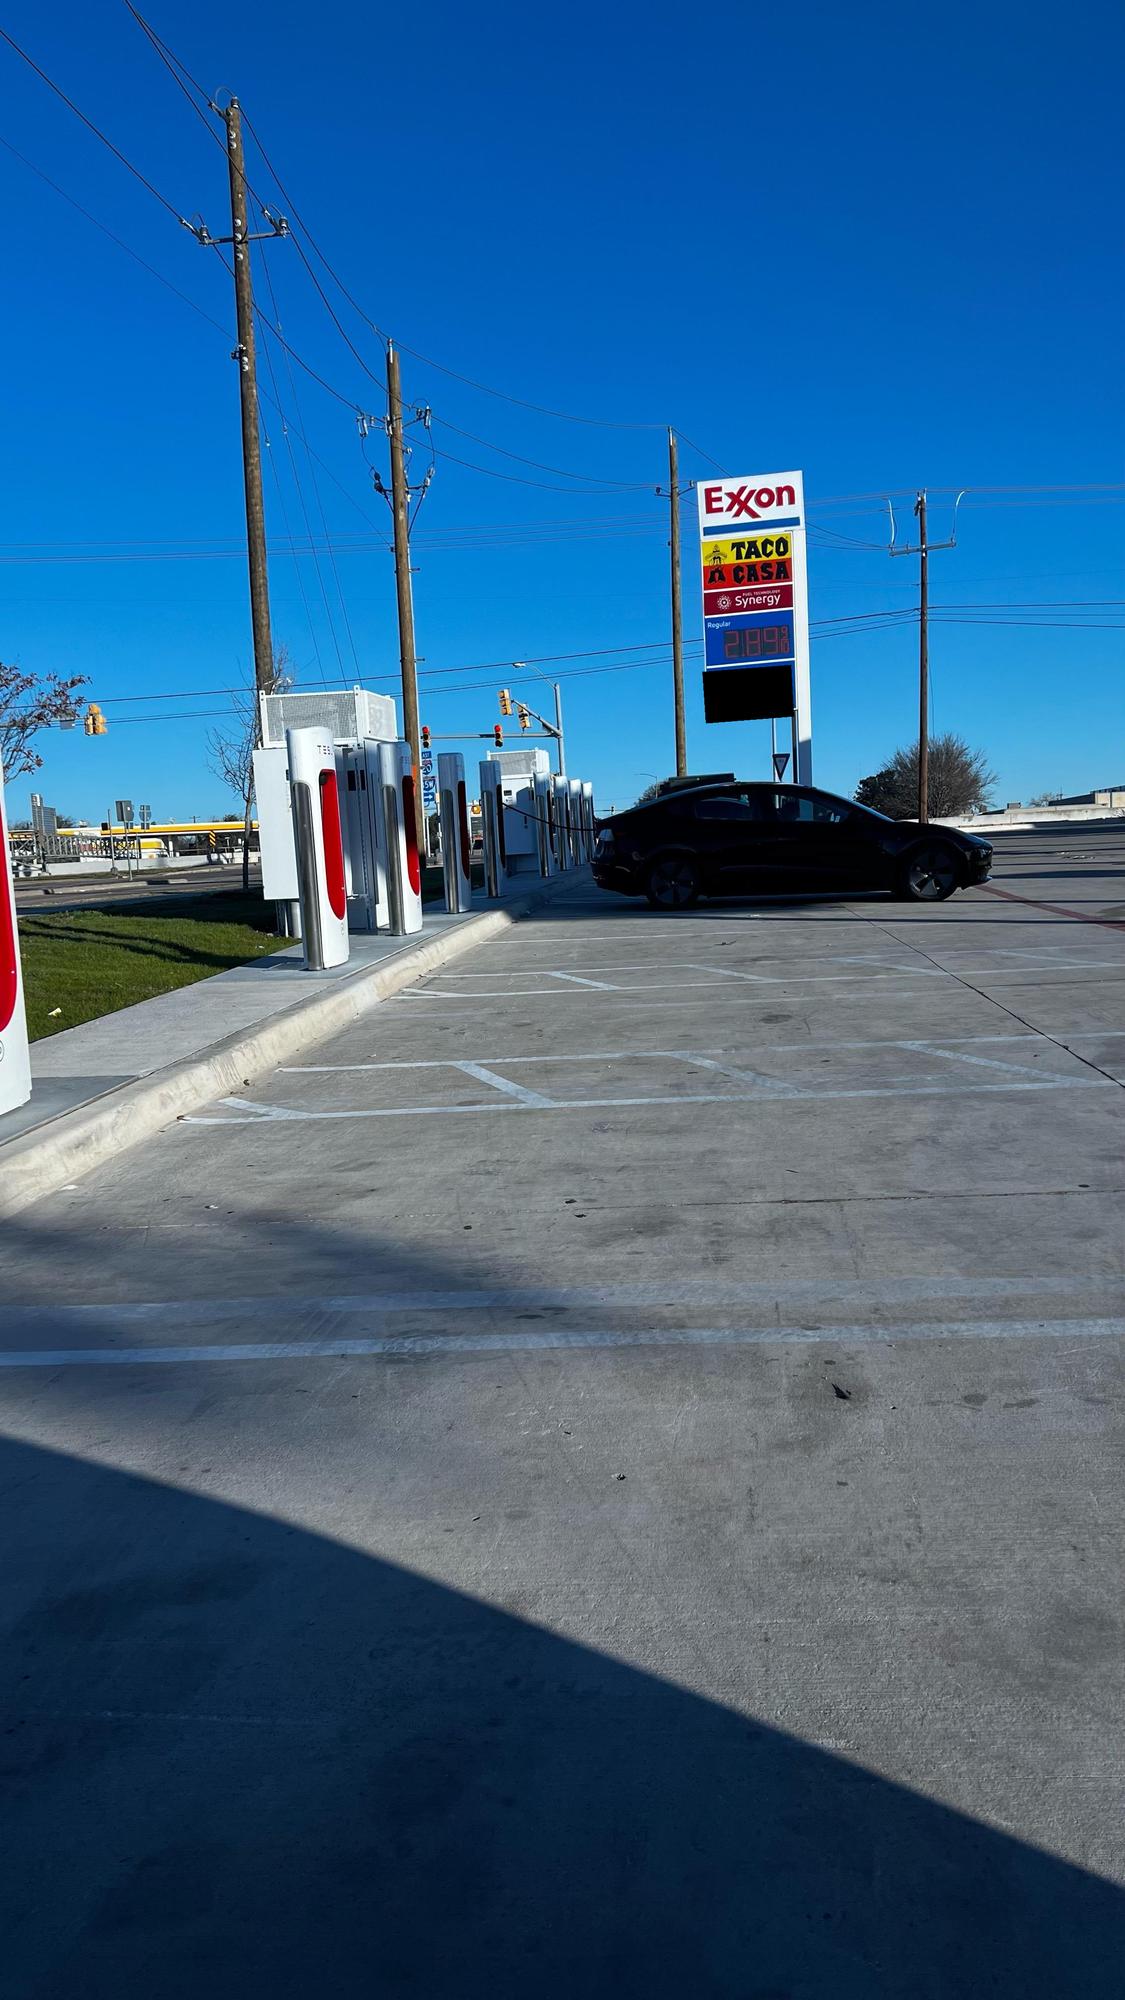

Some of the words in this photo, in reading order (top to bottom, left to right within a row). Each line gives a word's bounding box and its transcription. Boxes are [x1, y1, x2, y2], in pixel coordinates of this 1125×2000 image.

[704, 485, 796, 519] Exxon
[731, 536, 789, 561] TACO
[732, 561, 790, 584] CASA
[735, 594, 781, 608] Synergy
[707, 621, 731, 630] Regular
